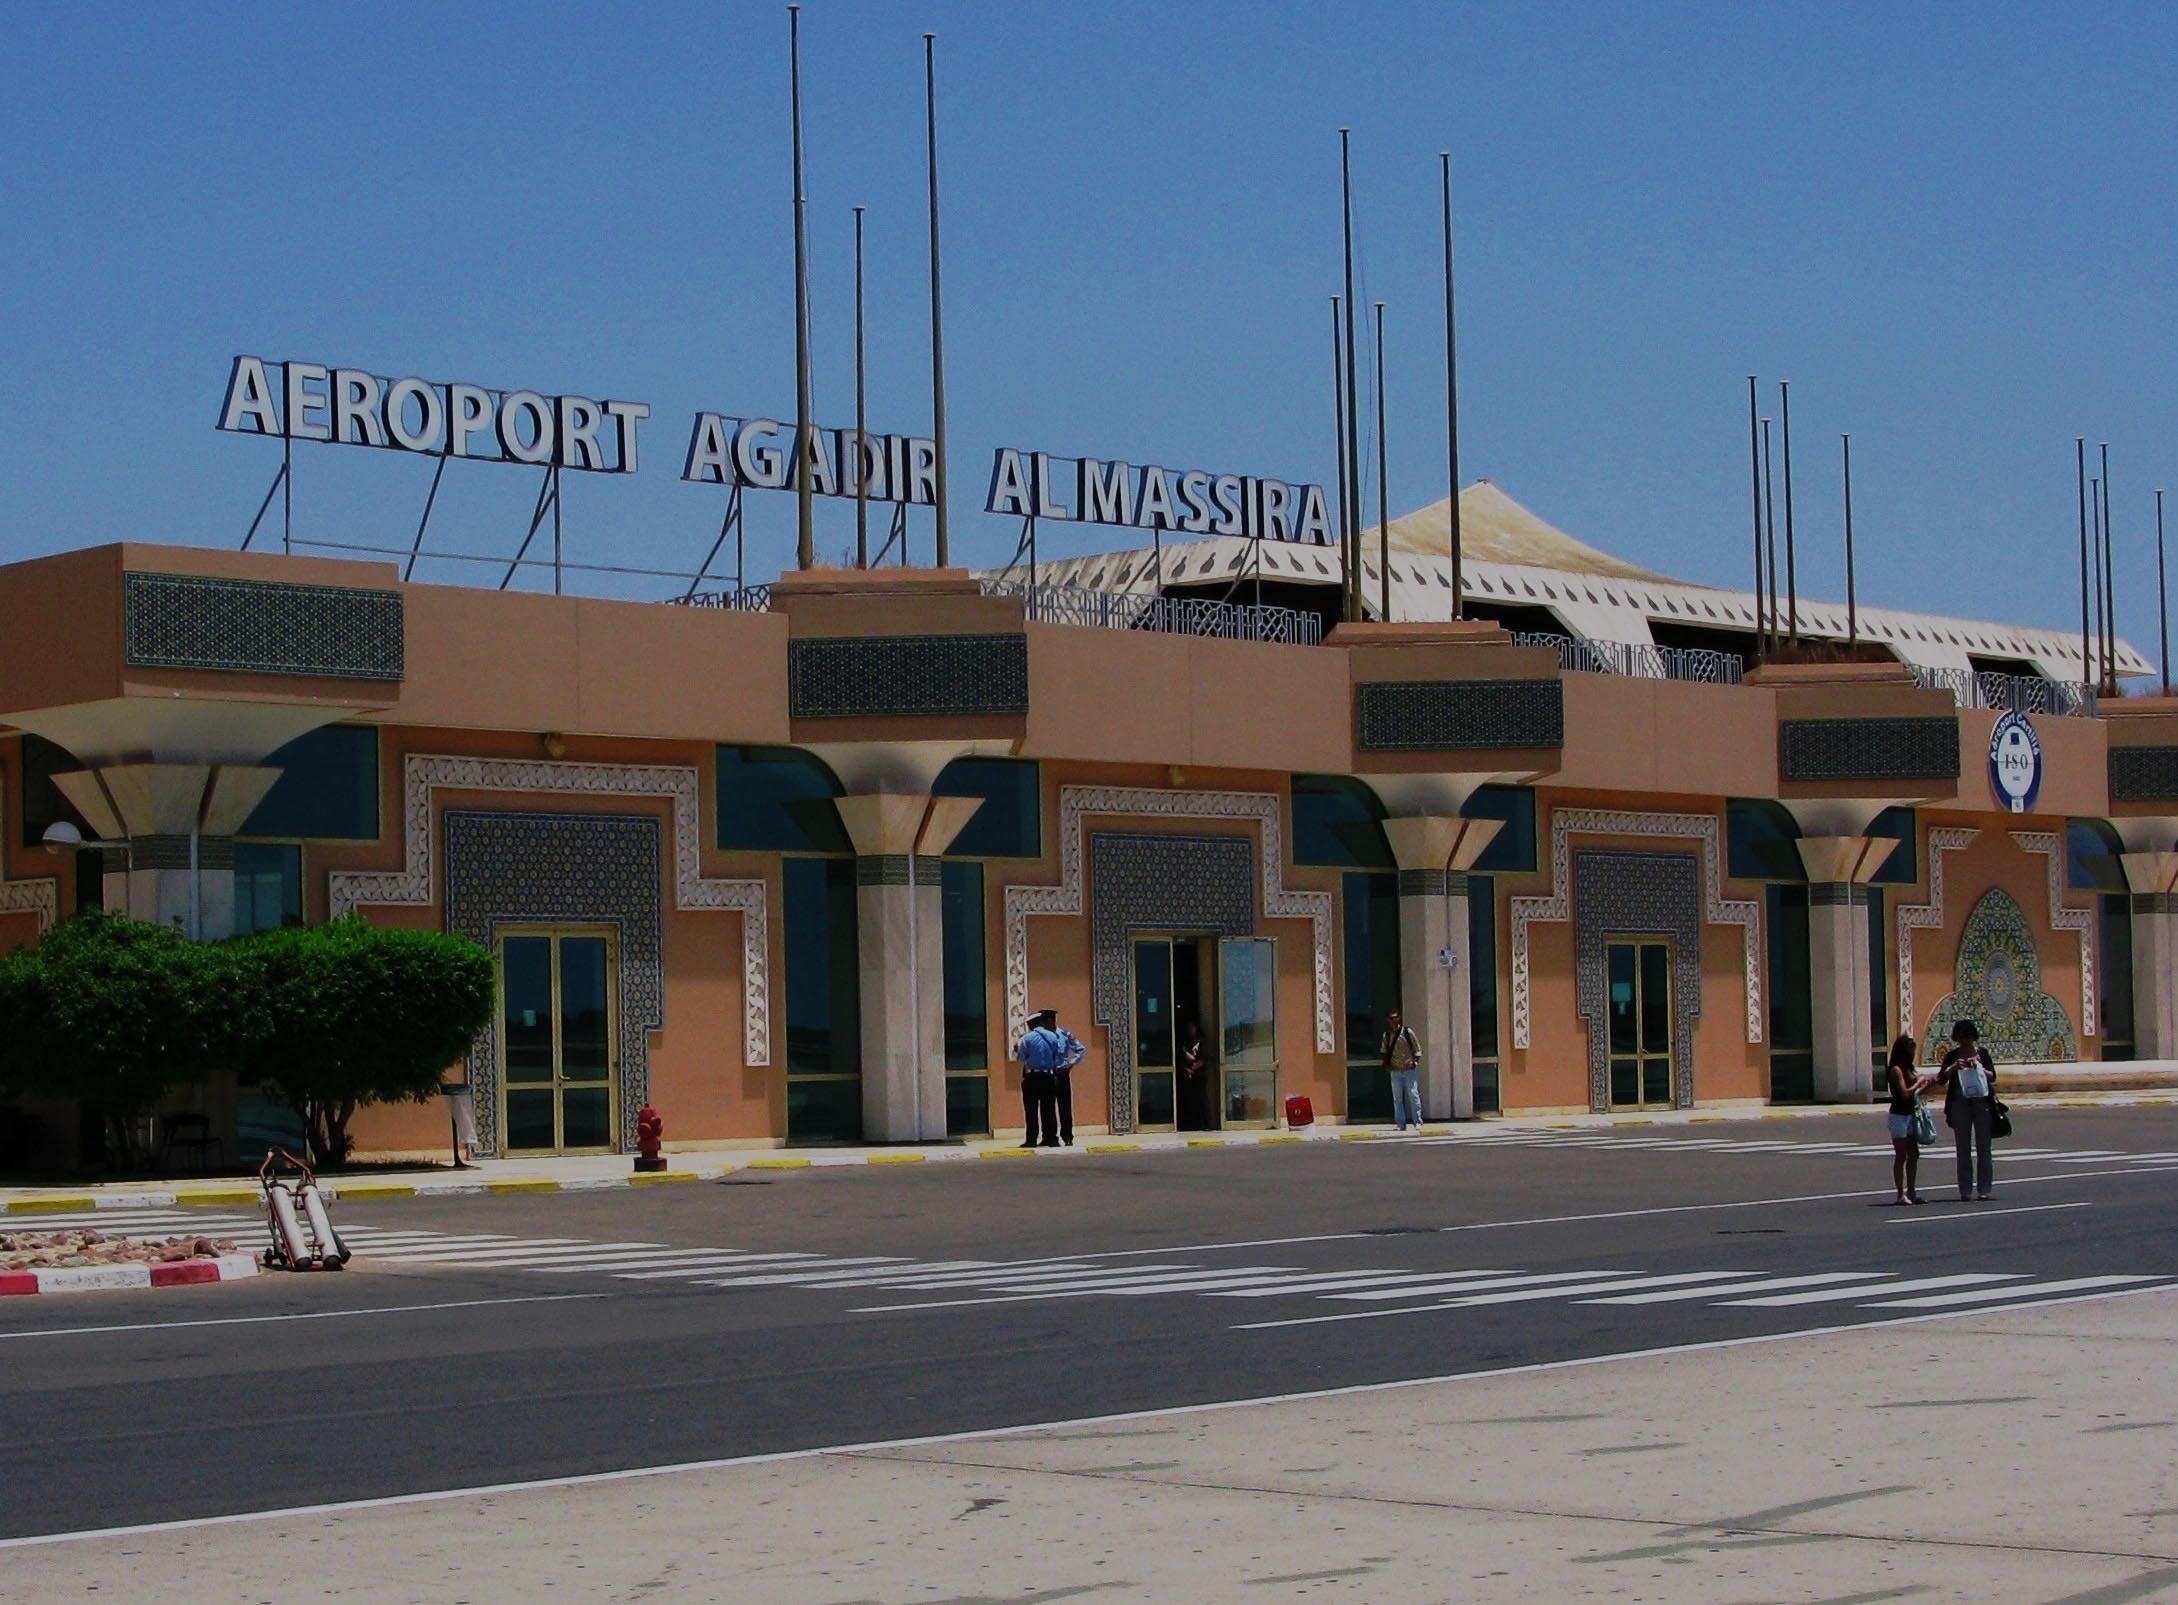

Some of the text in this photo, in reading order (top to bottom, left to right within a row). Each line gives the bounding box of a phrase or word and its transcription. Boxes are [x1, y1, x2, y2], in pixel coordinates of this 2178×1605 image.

[216, 355, 650, 474] AEROPORT
[681, 411, 937, 505] AGADIR
[1077, 457, 1334, 546] MASSIRA
[2004, 754, 2028, 769] ISO
